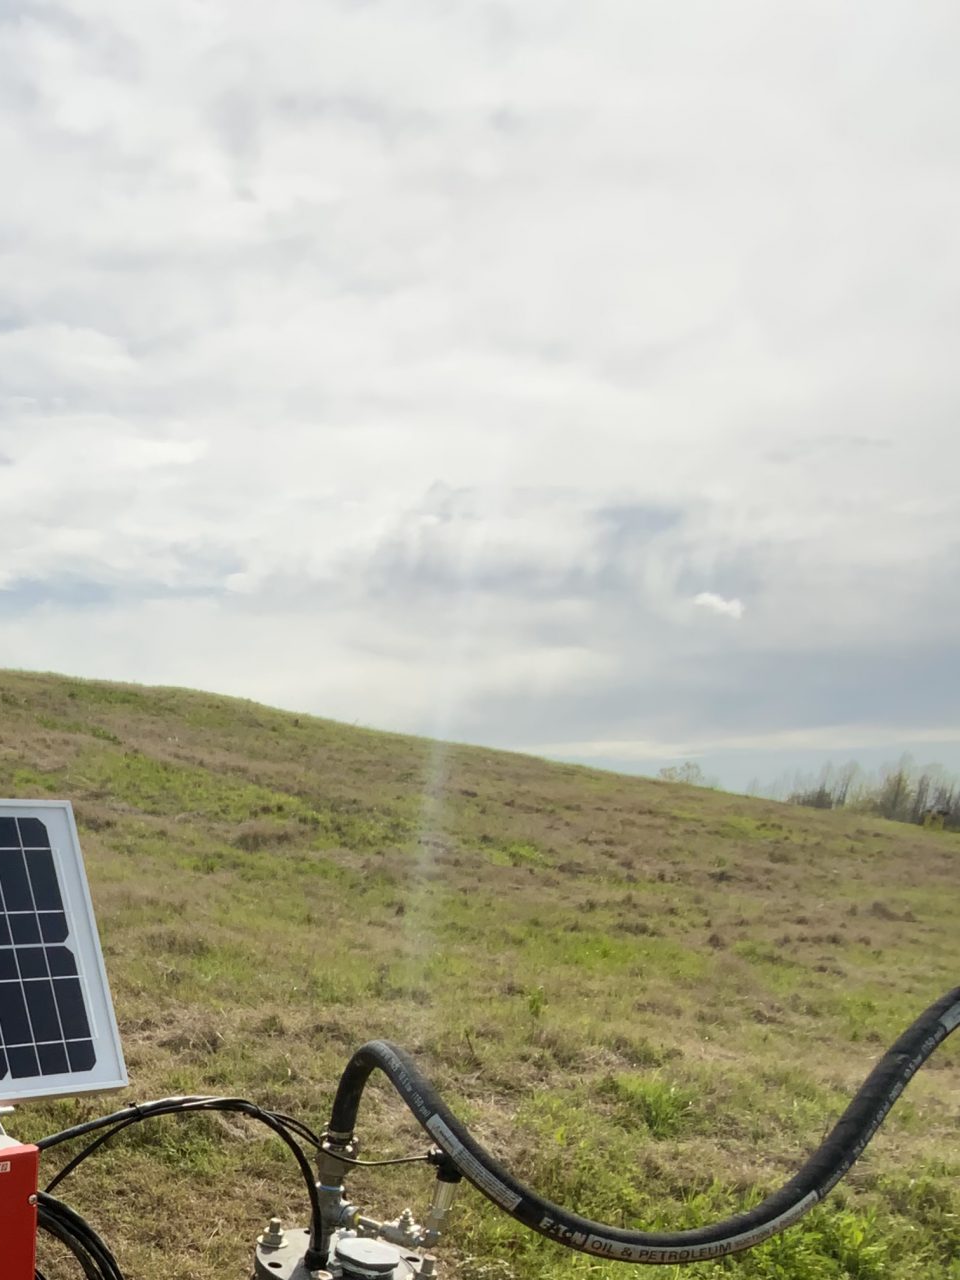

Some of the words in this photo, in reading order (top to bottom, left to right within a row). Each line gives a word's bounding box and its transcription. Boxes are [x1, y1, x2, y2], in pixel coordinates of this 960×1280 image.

[591, 1240, 614, 1256] OIL
[620, 1247, 632, 1258] &
[639, 1242, 732, 1262] PETROLEUM
